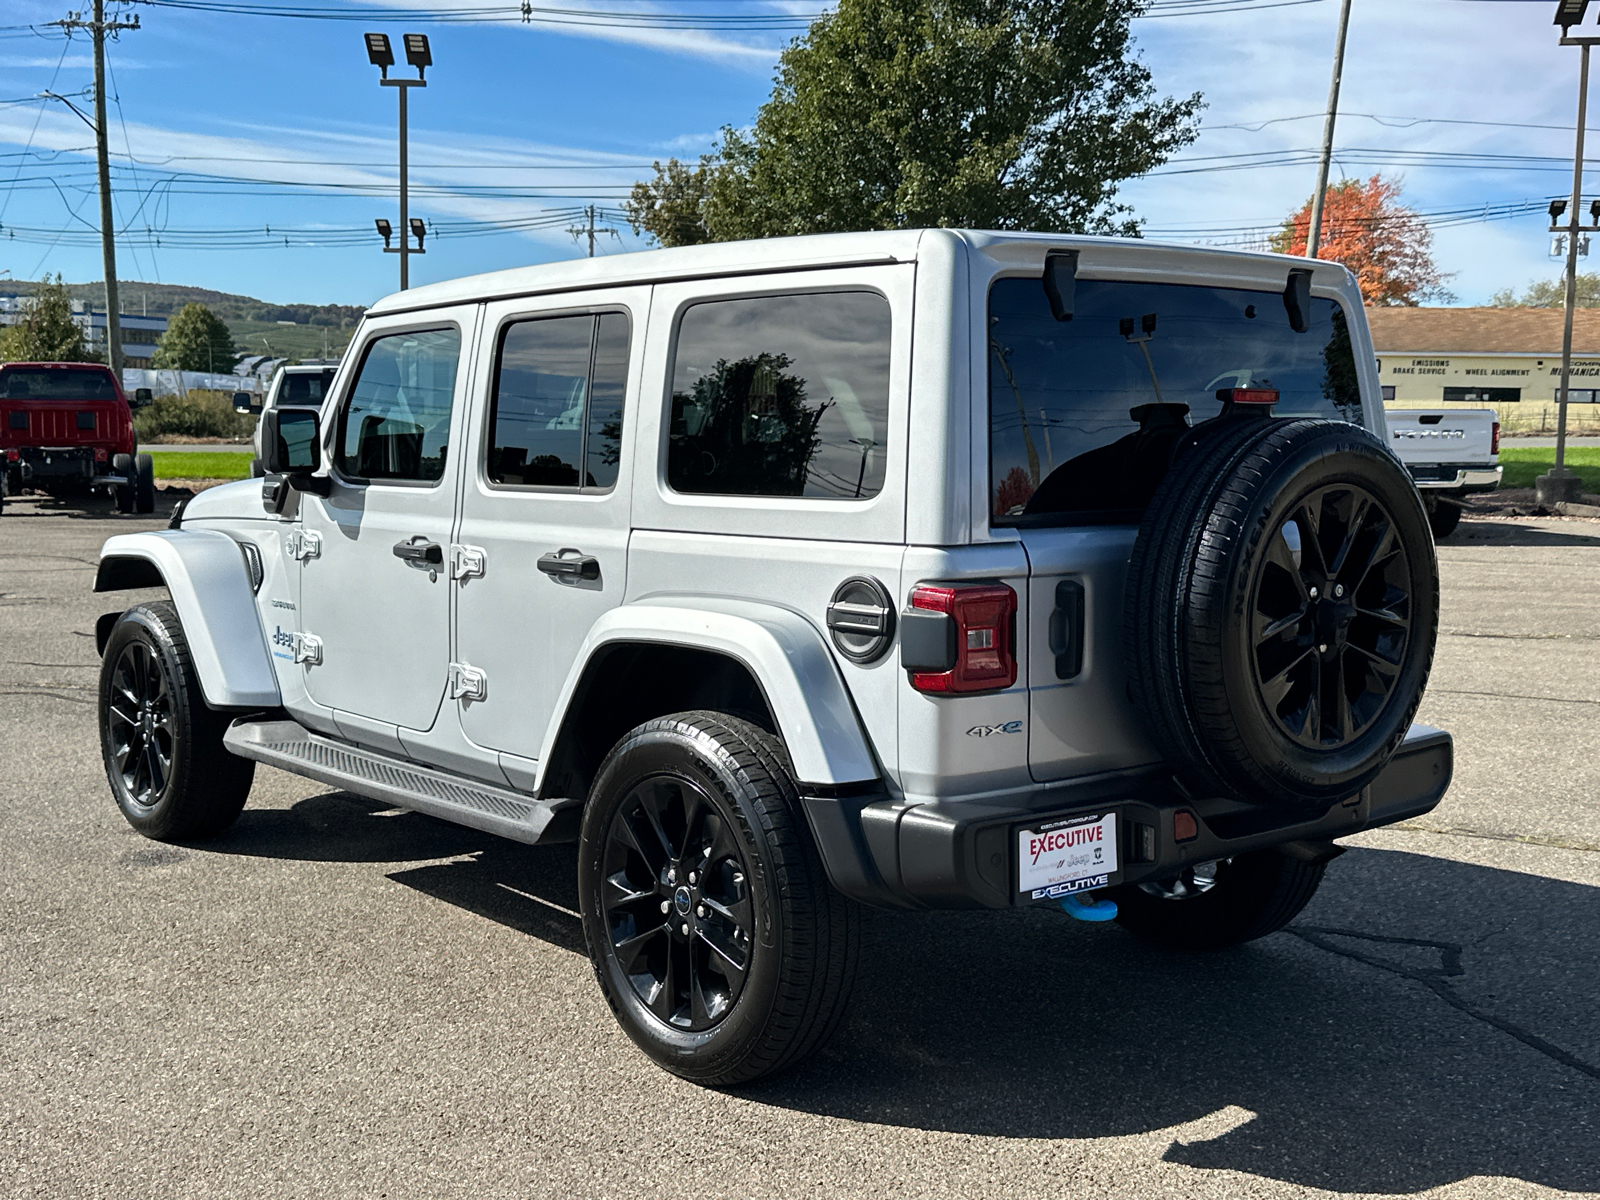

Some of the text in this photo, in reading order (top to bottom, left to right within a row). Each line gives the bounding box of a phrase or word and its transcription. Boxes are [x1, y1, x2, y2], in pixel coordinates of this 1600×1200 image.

[1491, 369, 1530, 377] ALIGNMENT
[1550, 367, 1600, 377] MEHANICA
[1393, 430, 1465, 439] RAM
[1234, 506, 1273, 615] NEXEN
[1030, 825, 1103, 866] EXECUTIVE
[1032, 874, 1108, 899] EXECUTIVE
